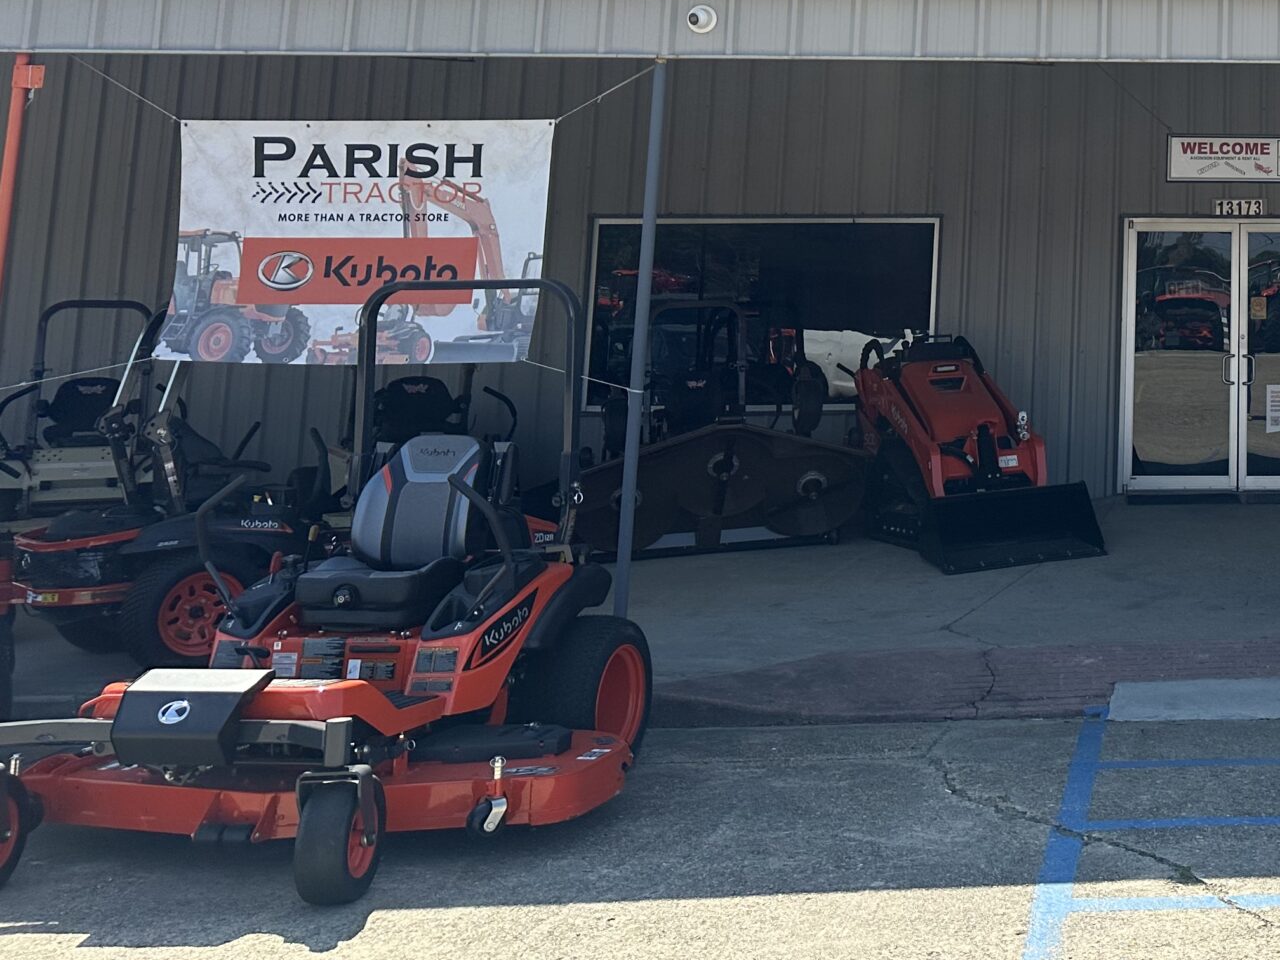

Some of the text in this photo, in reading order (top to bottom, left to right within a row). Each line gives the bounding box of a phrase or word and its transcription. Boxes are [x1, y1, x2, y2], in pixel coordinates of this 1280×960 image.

[252, 135, 485, 179] PARISH
[1180, 142, 1271, 155] WELCOME
[320, 181, 483, 204] TRACTOR
[1217, 200, 1262, 215] 13173
[278, 213, 449, 223] MORE THAN A TRACTOR STORE
[323, 255, 458, 286] Kubota
[240, 519, 279, 528] Kubota
[484, 606, 529, 646] Kubota
